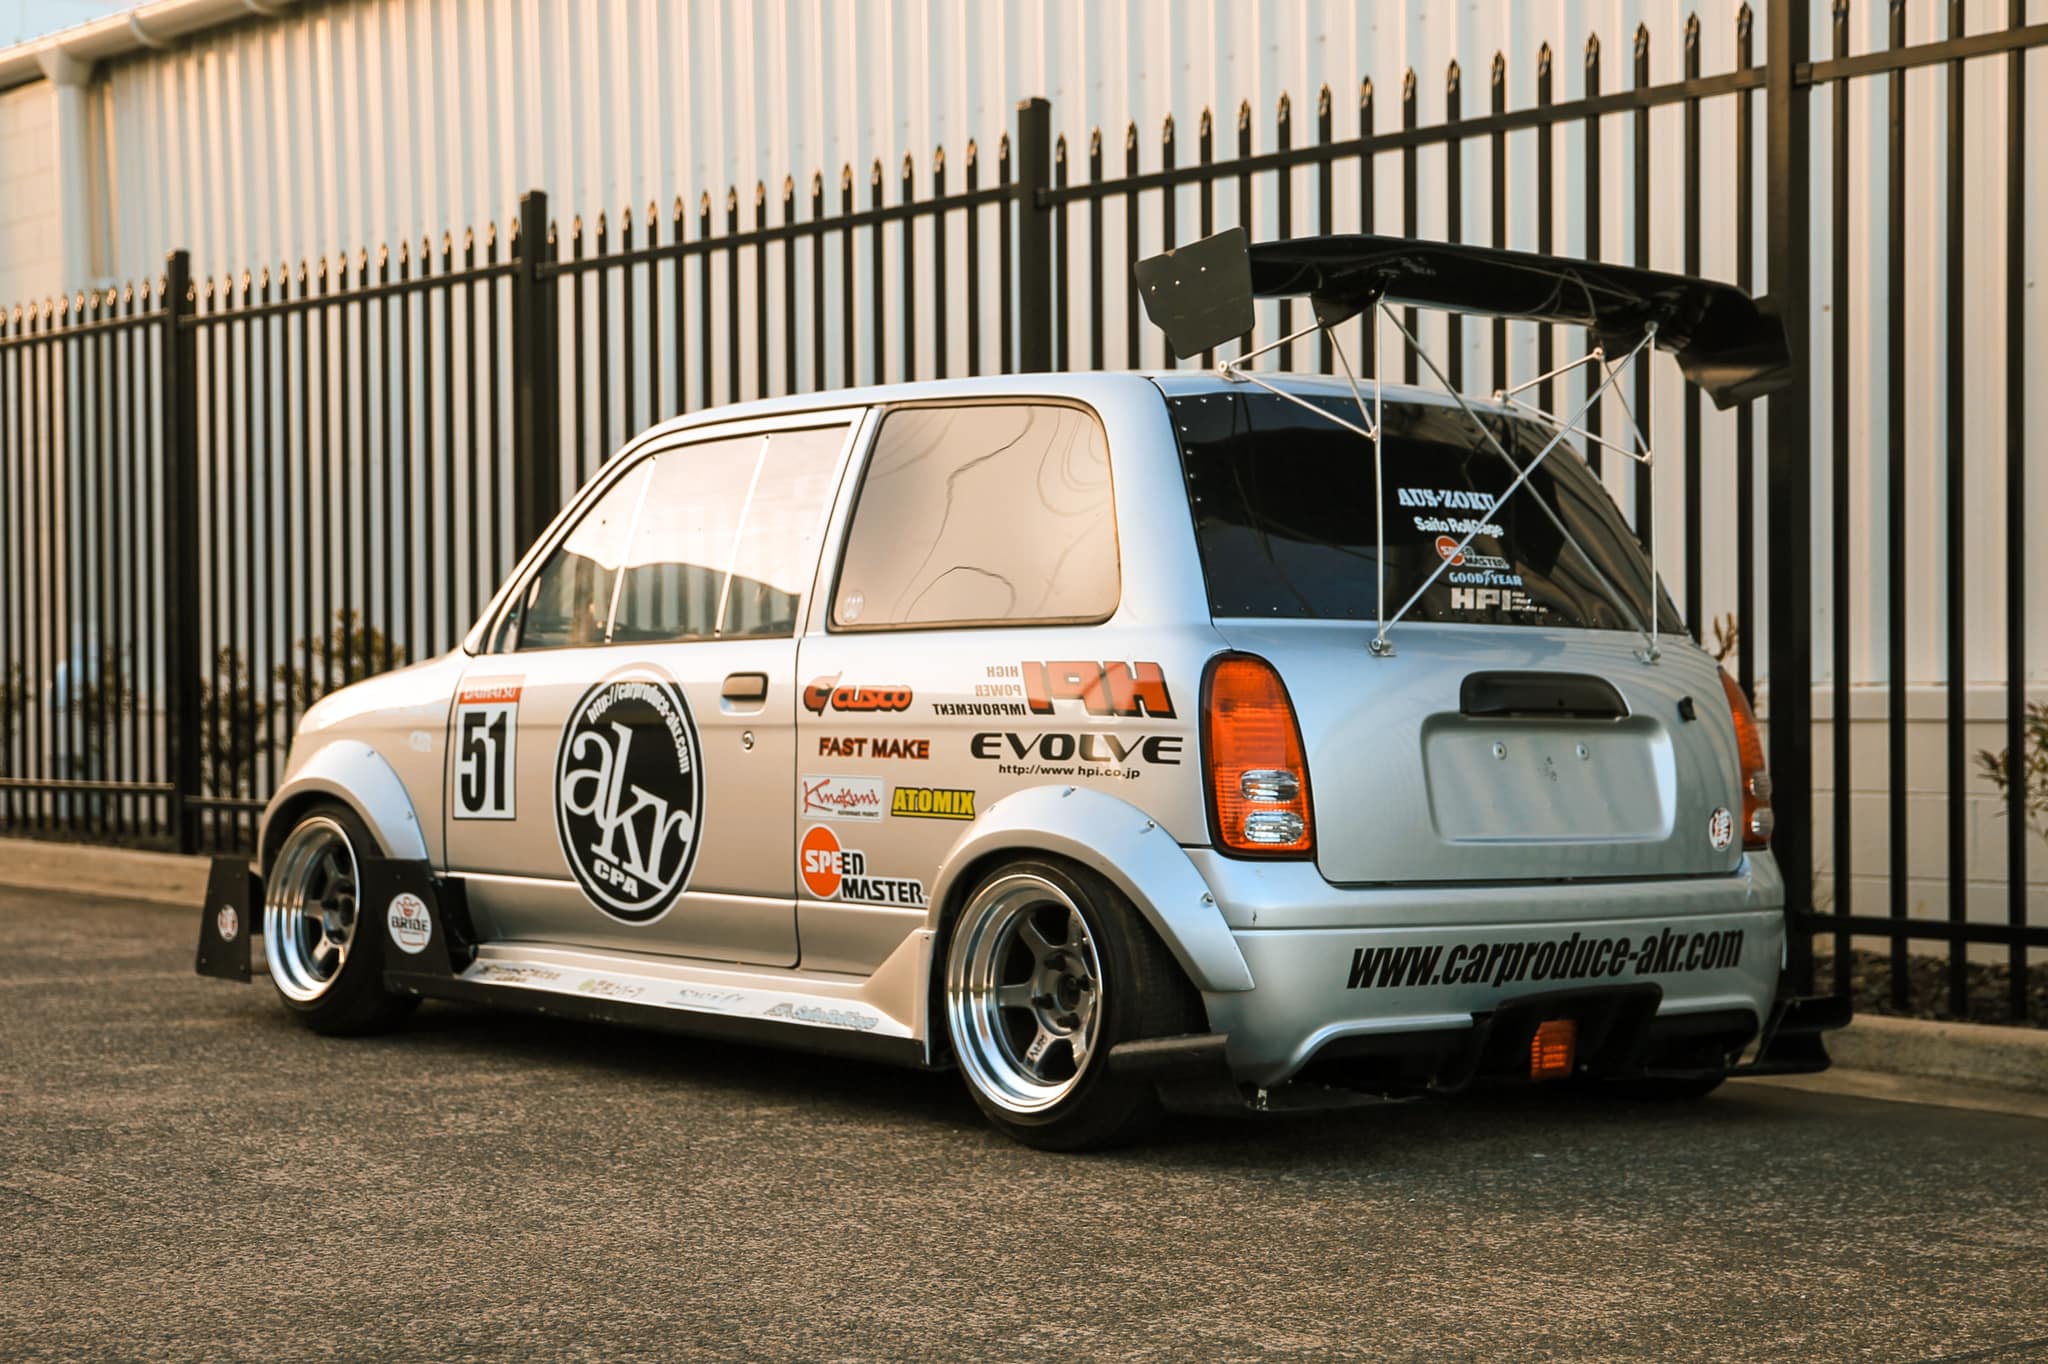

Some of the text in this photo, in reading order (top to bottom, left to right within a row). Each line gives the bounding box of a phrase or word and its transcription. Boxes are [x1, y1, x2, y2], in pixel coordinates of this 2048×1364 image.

[1413, 516, 1449, 532] Saito
[1449, 570, 1523, 586] GOODYEAR
[1451, 587, 1511, 611] HPI
[819, 737, 930, 759] FAST MAKE
[970, 732, 1183, 765] EVOLVE
[461, 711, 507, 812] 51
[998, 764, 1140, 779] http://wwwhpi.co.jp
[890, 787, 975, 817] ATOMIX
[805, 849, 864, 875] SPEED
[593, 859, 638, 898] CPA
[841, 877, 923, 904] MASTER
[391, 917, 429, 932] BRIDE
[1347, 927, 1744, 989] www.carproduce-akr.com
